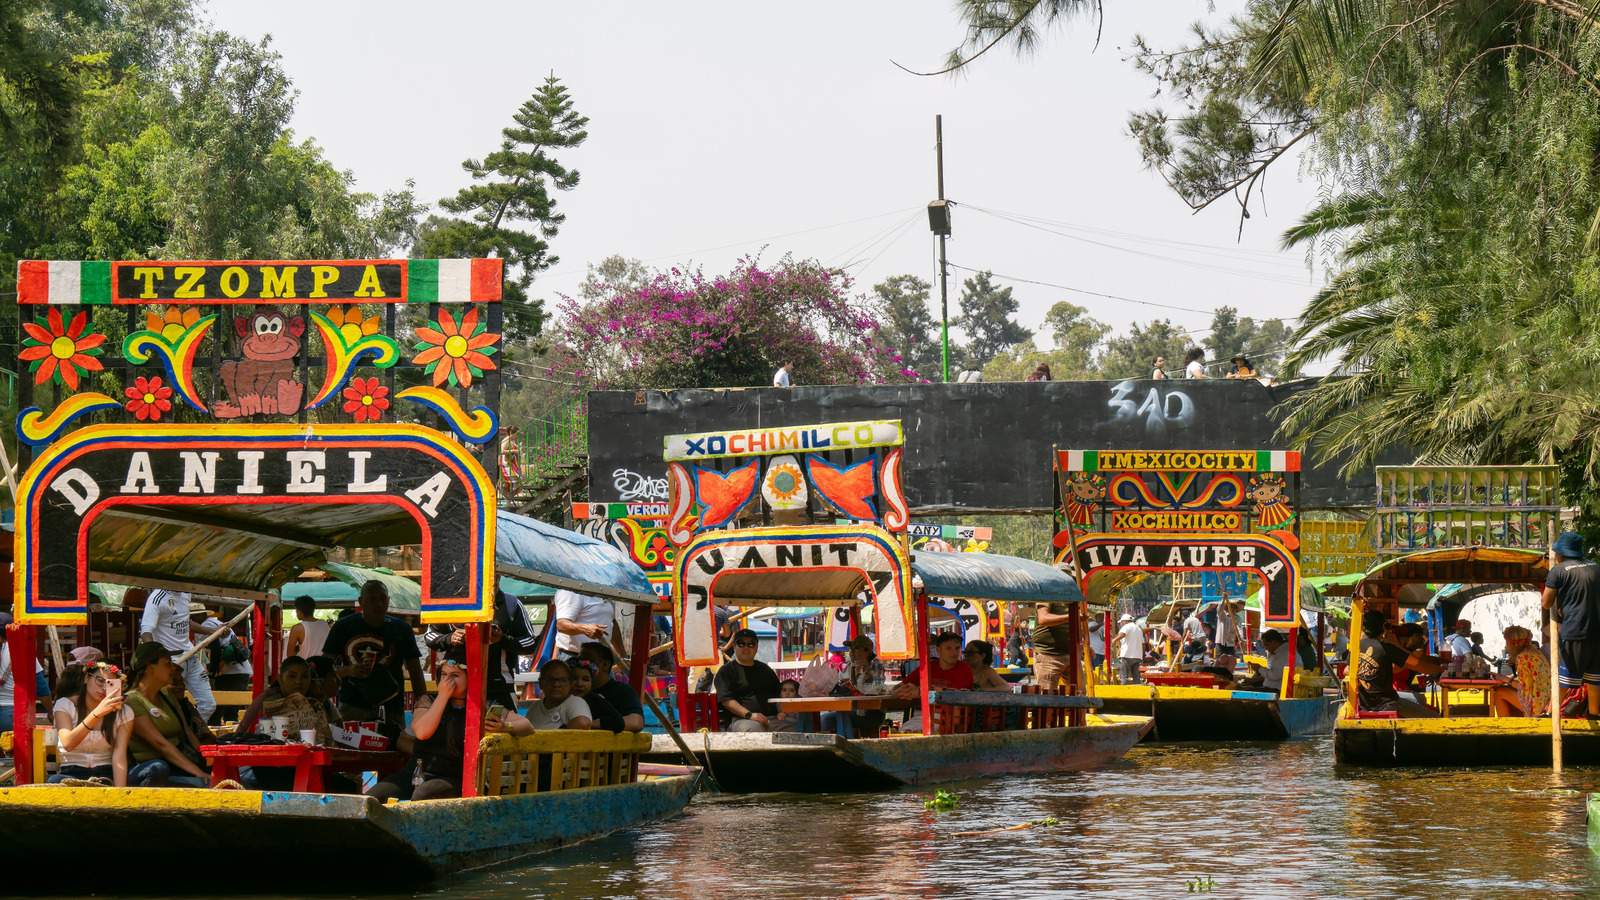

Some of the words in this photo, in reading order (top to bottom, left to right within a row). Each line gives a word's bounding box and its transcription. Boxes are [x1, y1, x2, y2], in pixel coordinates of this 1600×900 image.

[134, 265, 386, 299] TZOMPA
[685, 425, 874, 456] XOCHIMILCO
[1100, 452, 1254, 470] TMEXICOCITY
[50, 451, 452, 518] DANIELA
[626, 504, 670, 516] VERON
[1114, 513, 1240, 529] XOCHIMILCO
[687, 543, 893, 611] JUANITA
